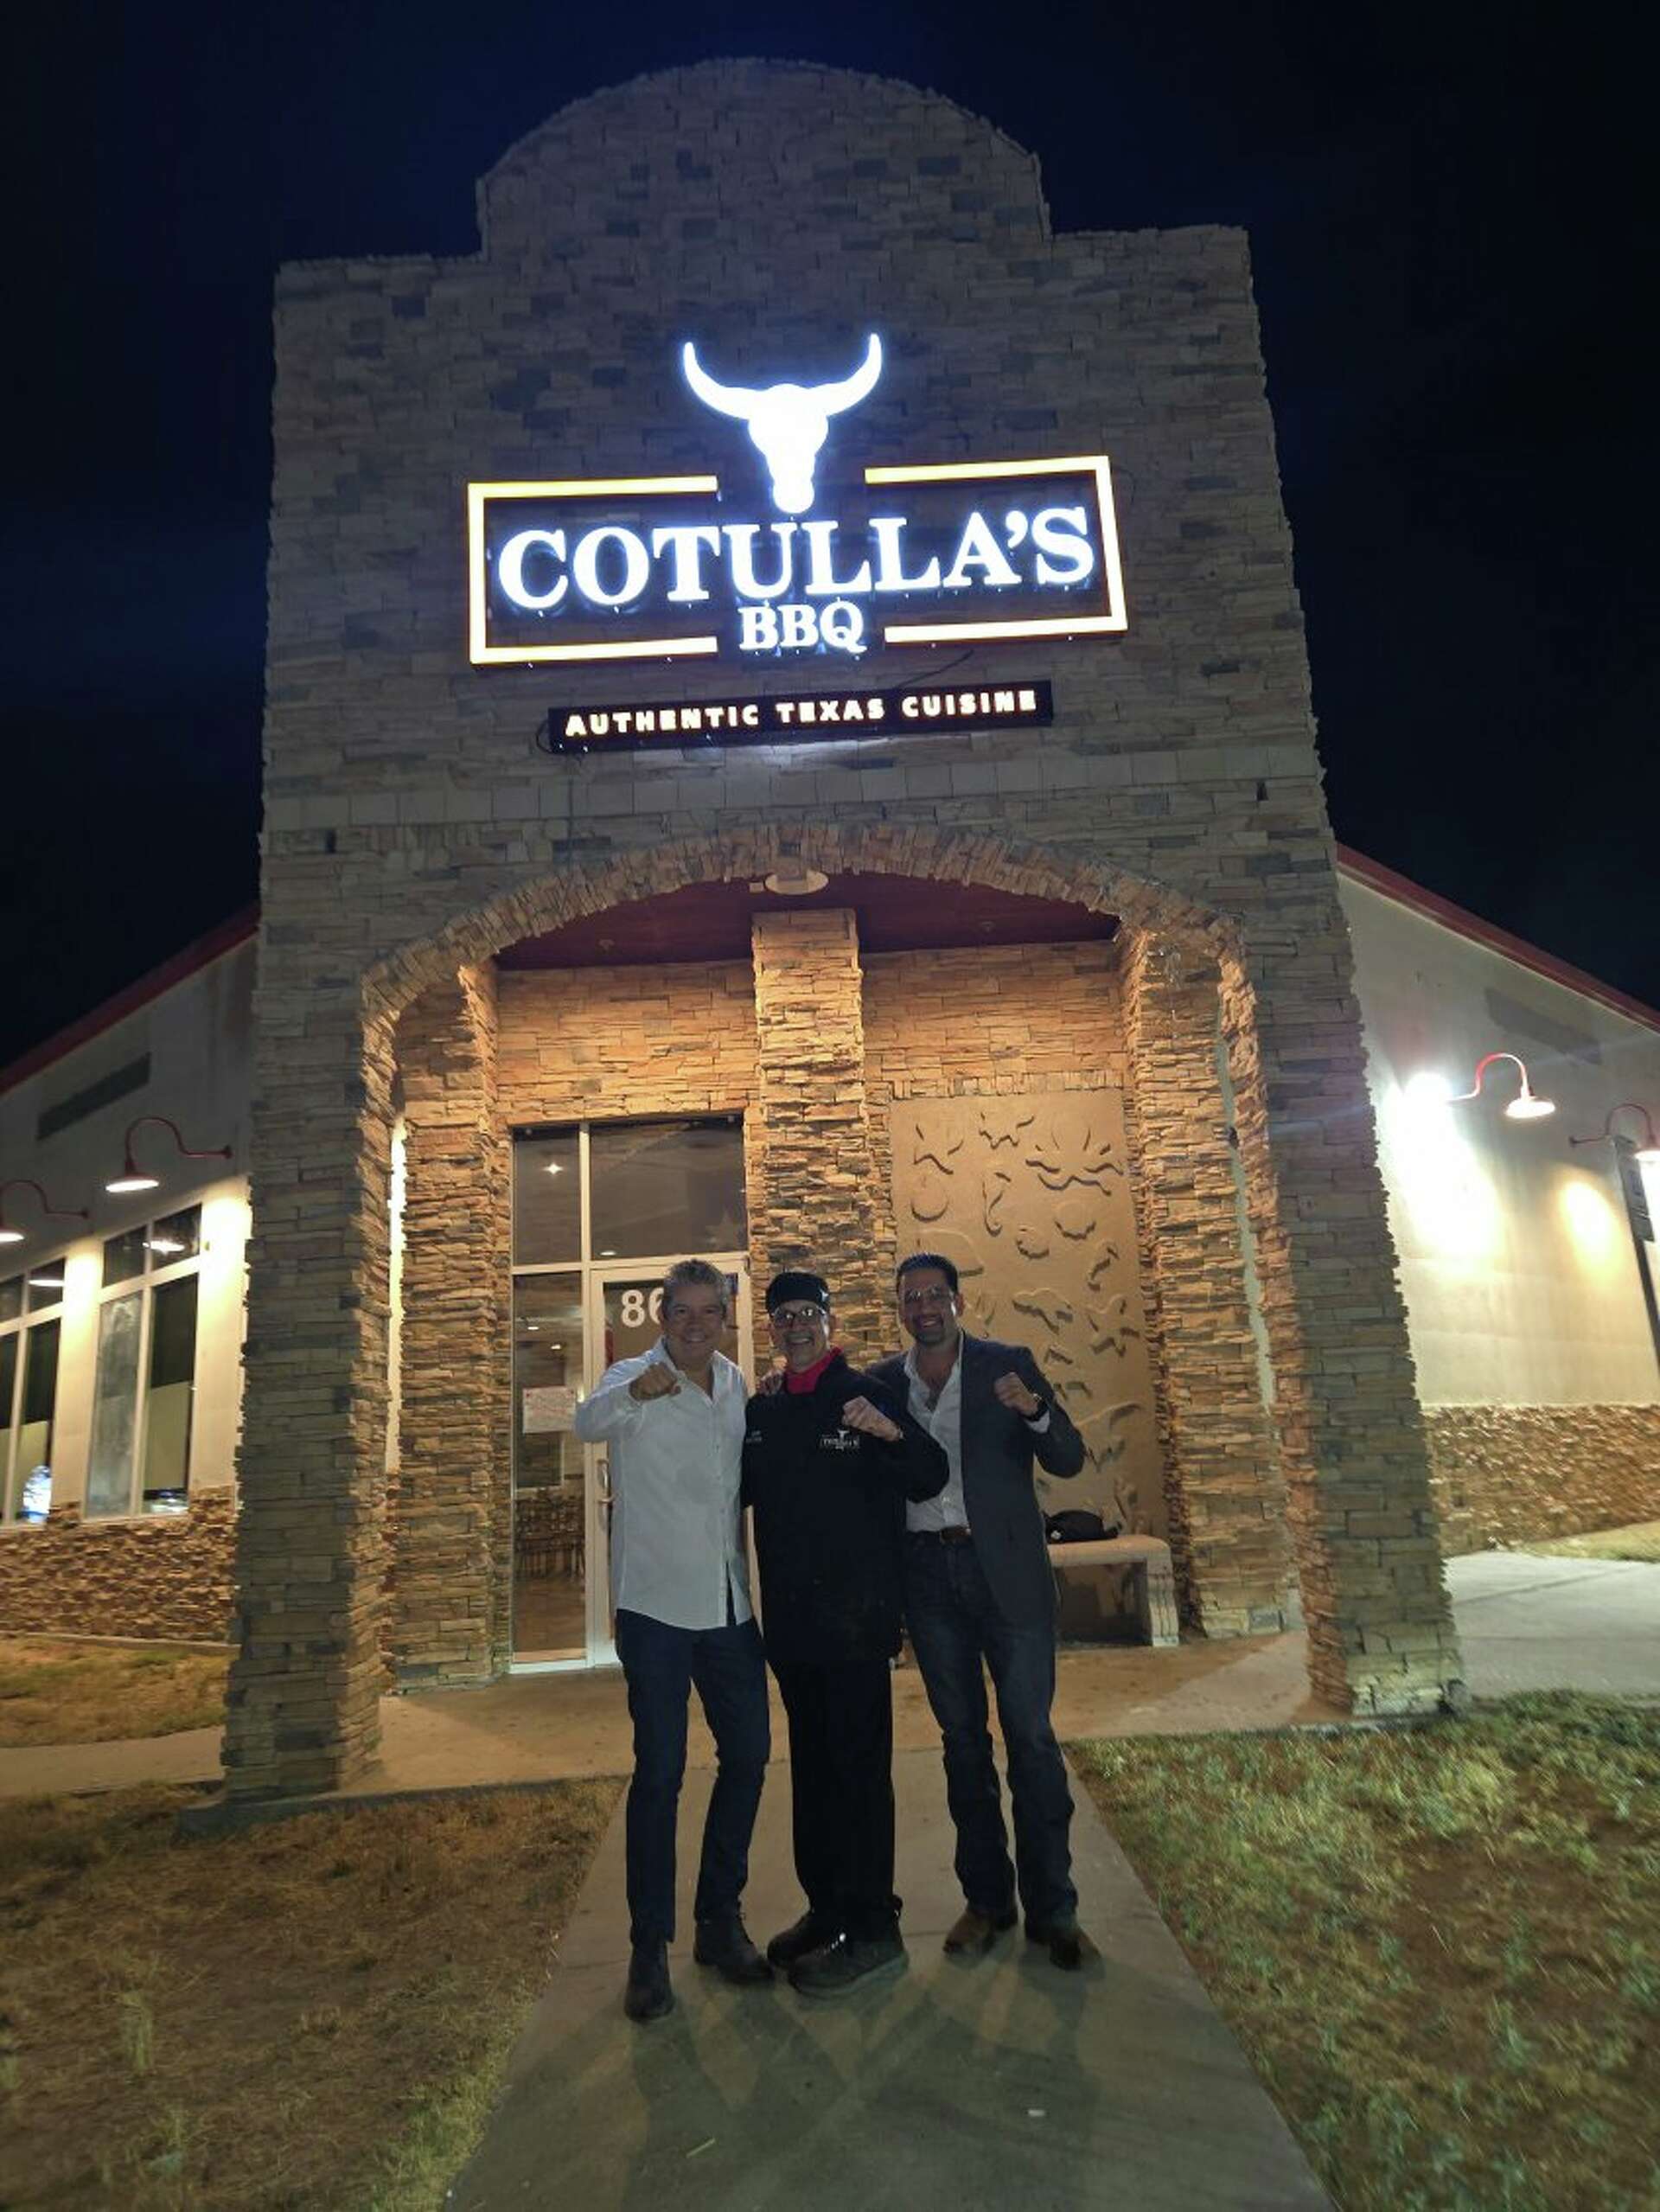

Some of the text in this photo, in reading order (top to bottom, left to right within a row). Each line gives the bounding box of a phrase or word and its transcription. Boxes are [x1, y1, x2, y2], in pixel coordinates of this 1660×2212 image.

[498, 506, 1095, 610] COTULLA'S
[737, 600, 867, 653] BBQ
[565, 690, 1037, 737] AUTHENTIC TEXAS CUISINE
